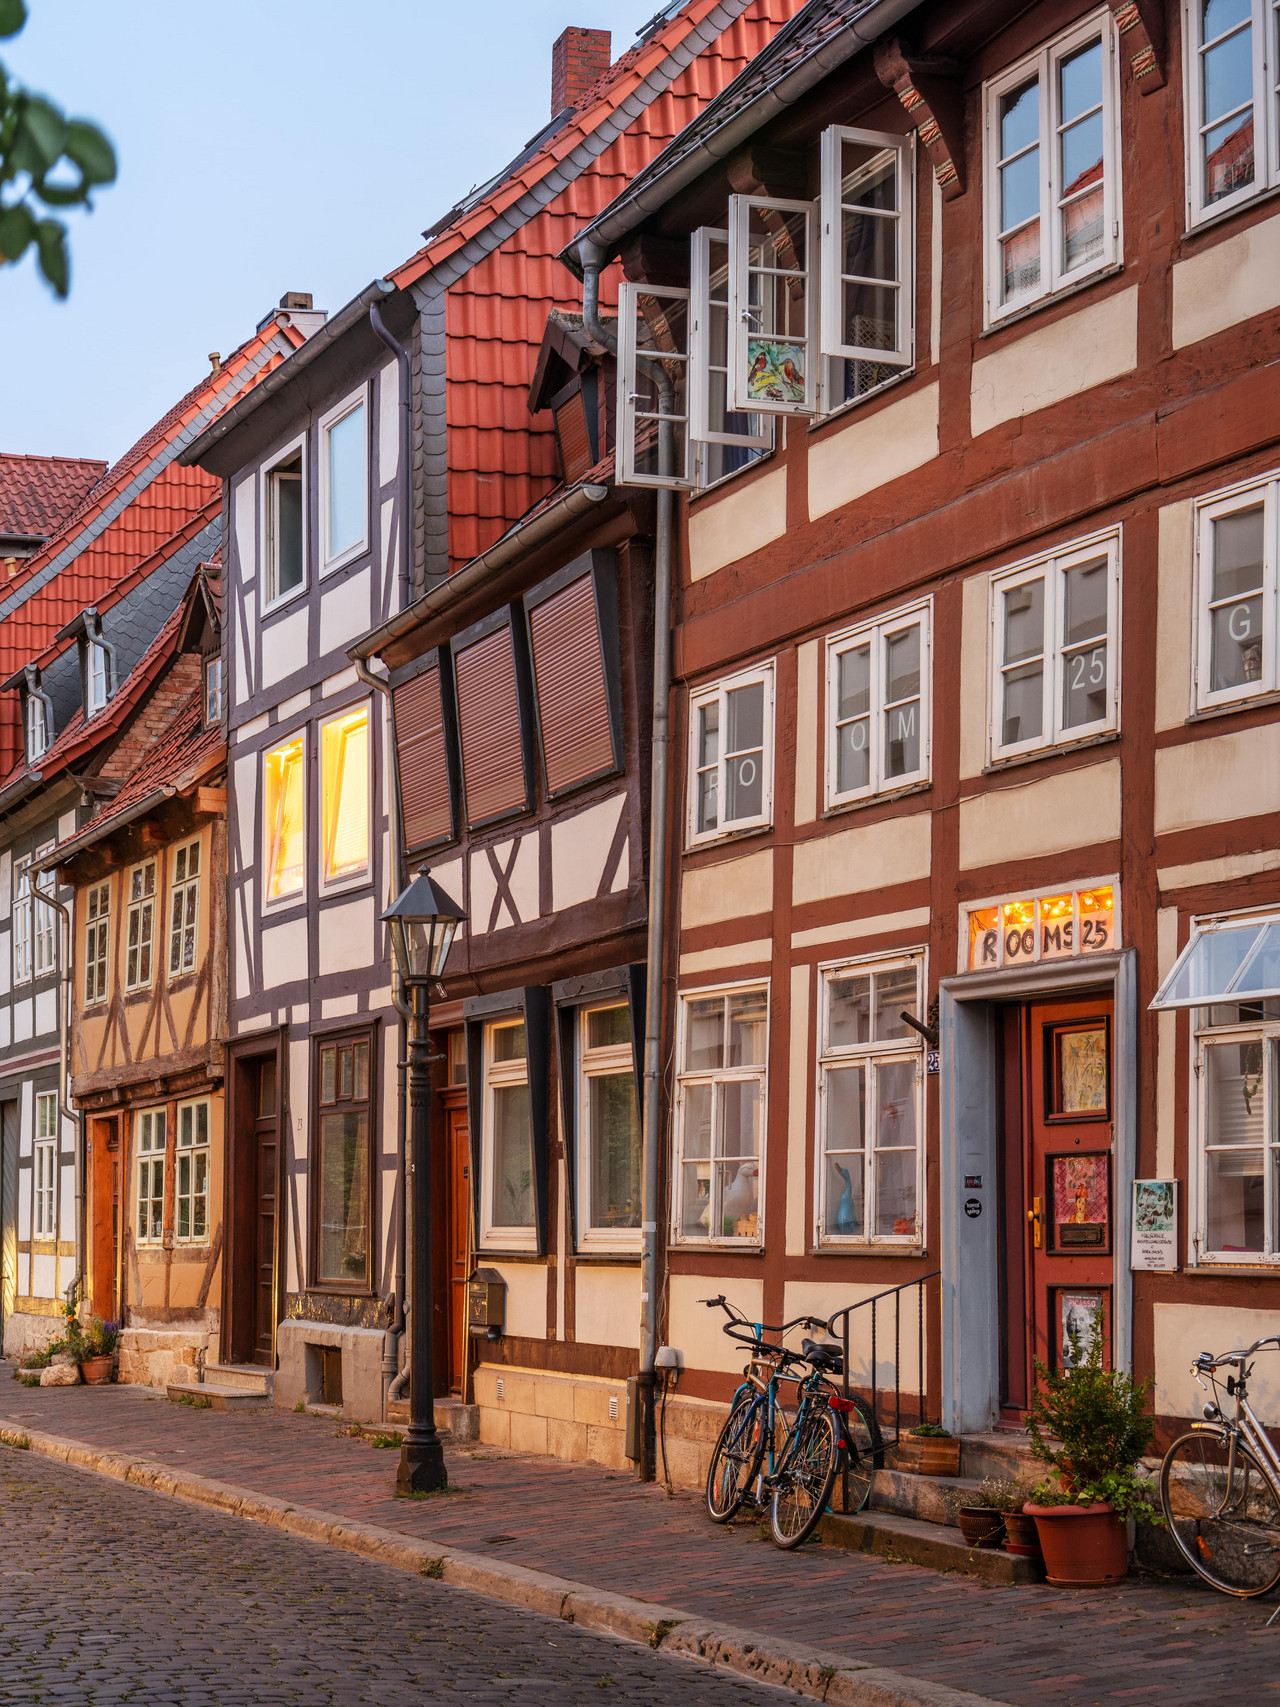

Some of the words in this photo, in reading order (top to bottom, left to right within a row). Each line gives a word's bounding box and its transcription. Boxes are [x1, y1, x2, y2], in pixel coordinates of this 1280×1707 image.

[1071, 647, 1105, 691] 25
[1228, 603, 1251, 641] G
[982, 921, 1073, 963] ROOMS
[1081, 919, 1109, 950] 25
[928, 1053, 940, 1071] 25
[1068, 1299, 1096, 1308] PICASSO
